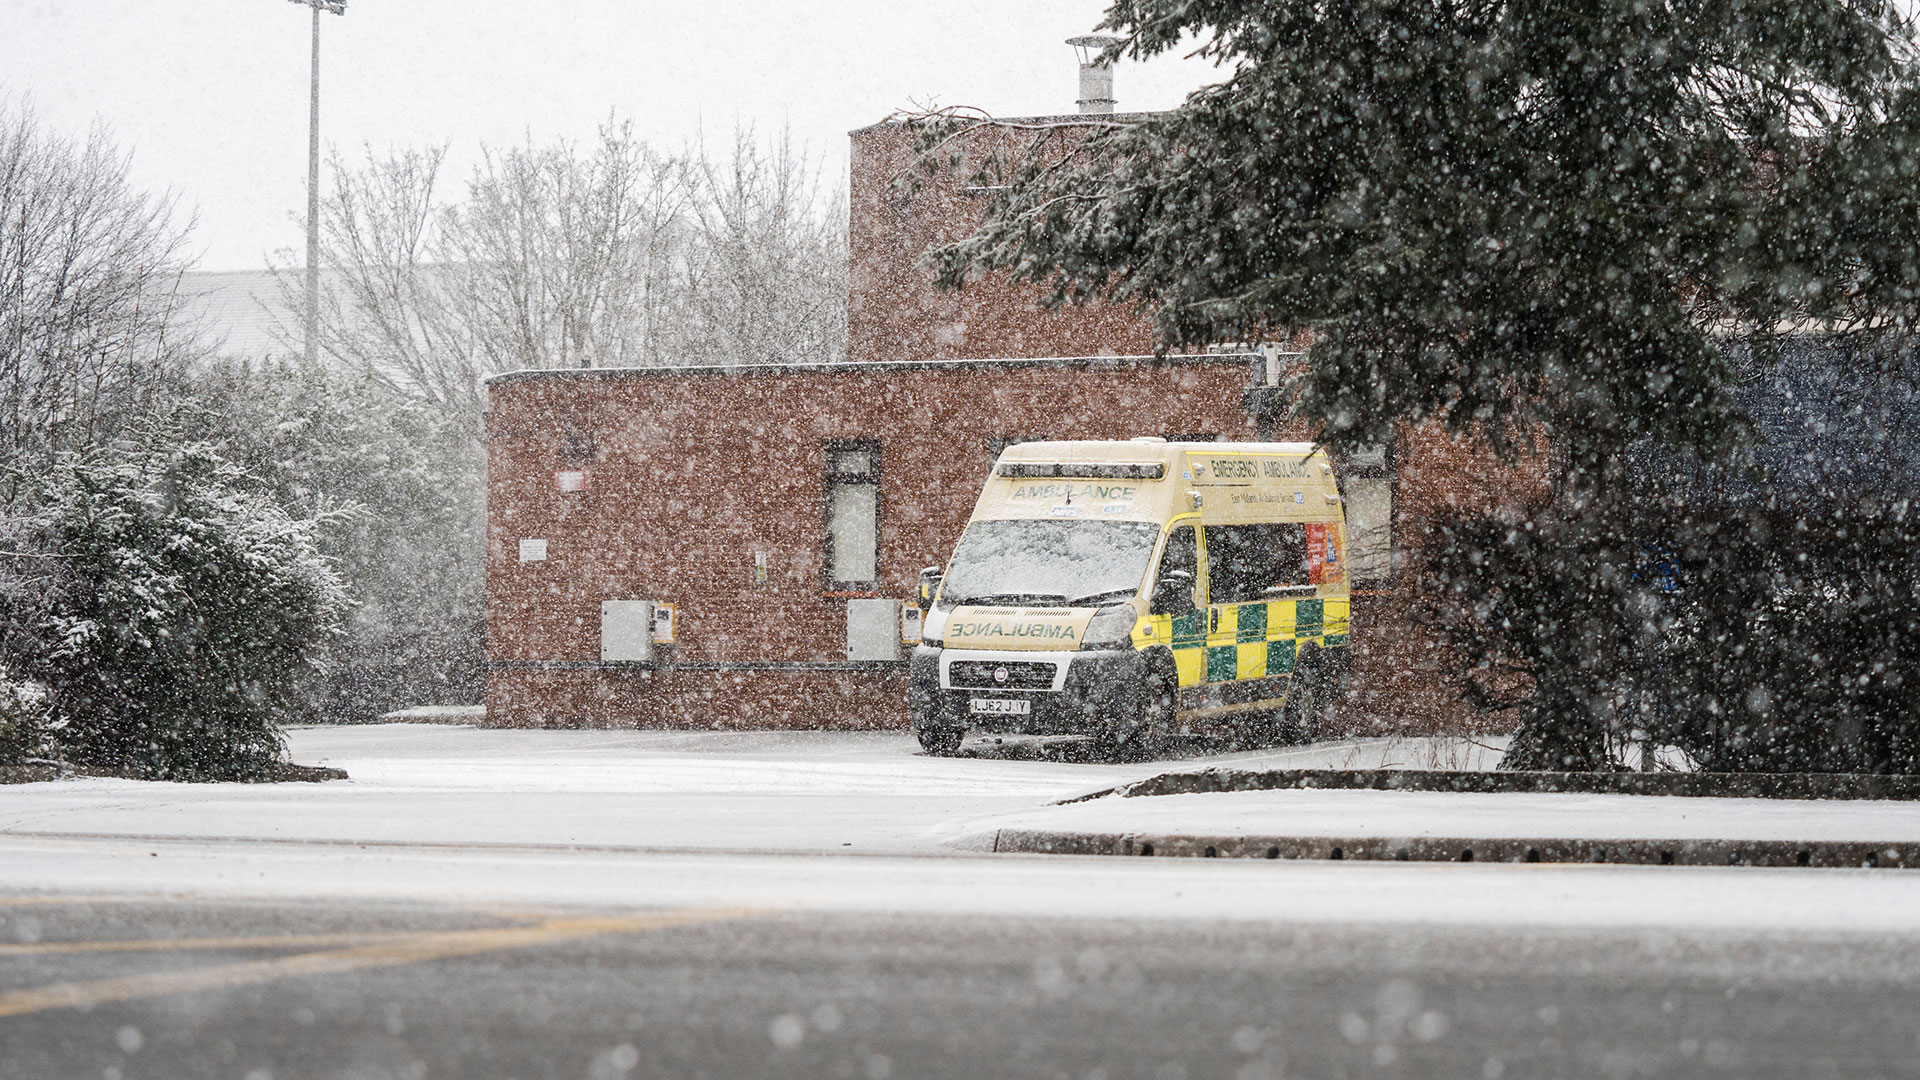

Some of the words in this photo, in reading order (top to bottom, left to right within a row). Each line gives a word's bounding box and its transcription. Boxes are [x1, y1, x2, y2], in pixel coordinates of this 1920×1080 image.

[1211, 460, 1260, 478] EMERGENCY
[1013, 484, 1137, 500] AMBULANCE
[974, 700, 1003, 712] LJ62
[1005, 701, 1026, 713] JY
